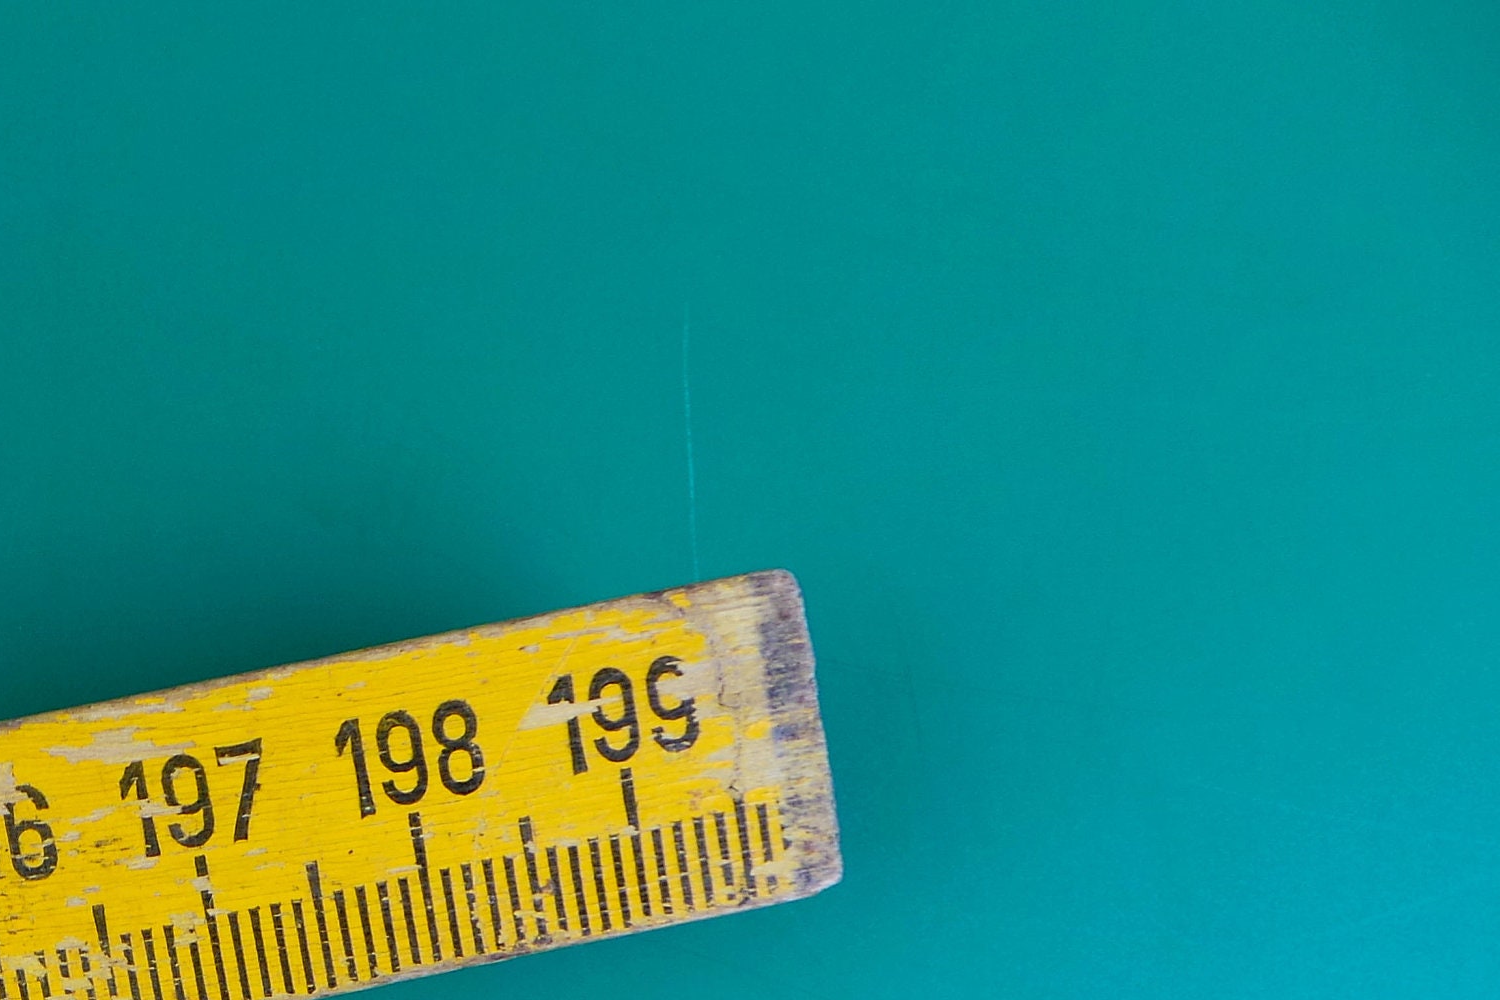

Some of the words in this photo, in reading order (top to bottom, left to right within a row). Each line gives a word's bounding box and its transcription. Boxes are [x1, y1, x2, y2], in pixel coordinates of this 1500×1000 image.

[119, 738, 263, 858] 197
[334, 699, 487, 819] 198
[547, 655, 700, 776] 199
